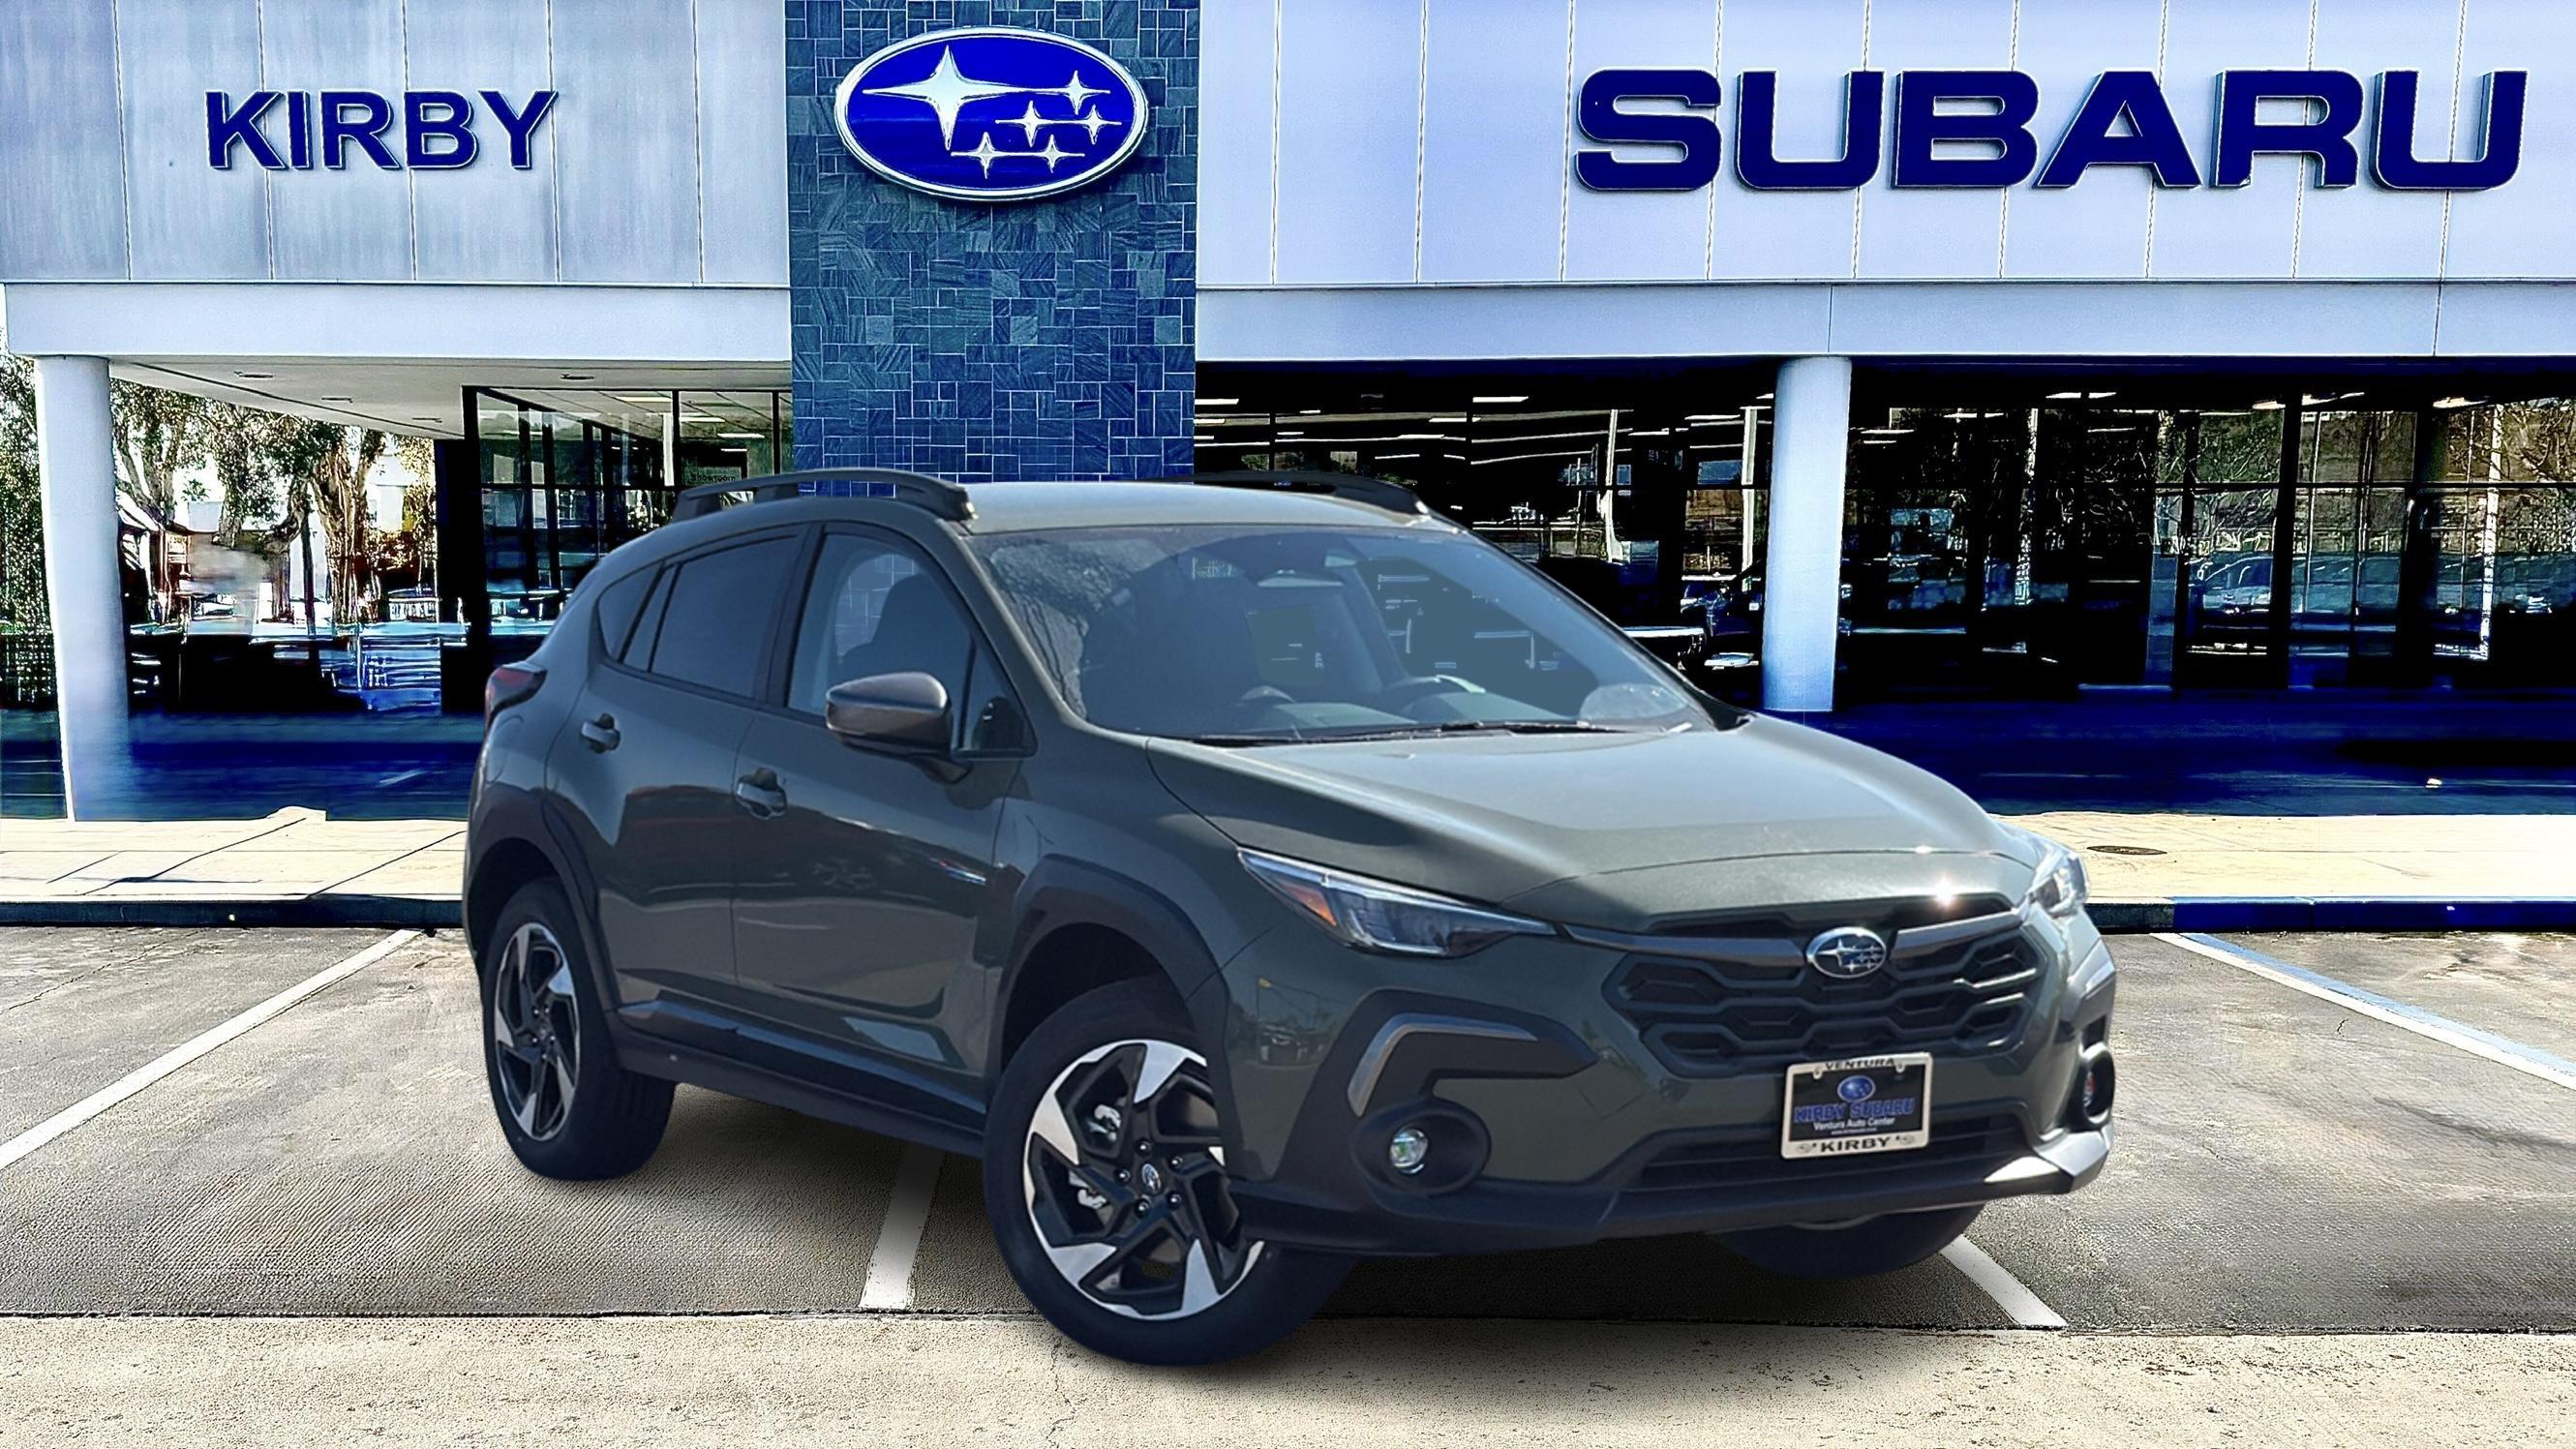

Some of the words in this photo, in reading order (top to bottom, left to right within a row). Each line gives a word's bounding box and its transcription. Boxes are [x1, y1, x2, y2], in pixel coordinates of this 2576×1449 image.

[204, 90, 559, 169] KIRBY
[1575, 68, 2528, 192] SUBARU
[1825, 1058, 1894, 1071] VENTURA
[1795, 1103, 1845, 1123] KIRBY
[1850, 1099, 1915, 1119] SUBARU
[1813, 1120, 1845, 1131] Ventura
[1846, 1117, 1866, 1129] Auto
[1867, 1115, 1895, 1127] Center
[1820, 1136, 1891, 1153] KIRBY
